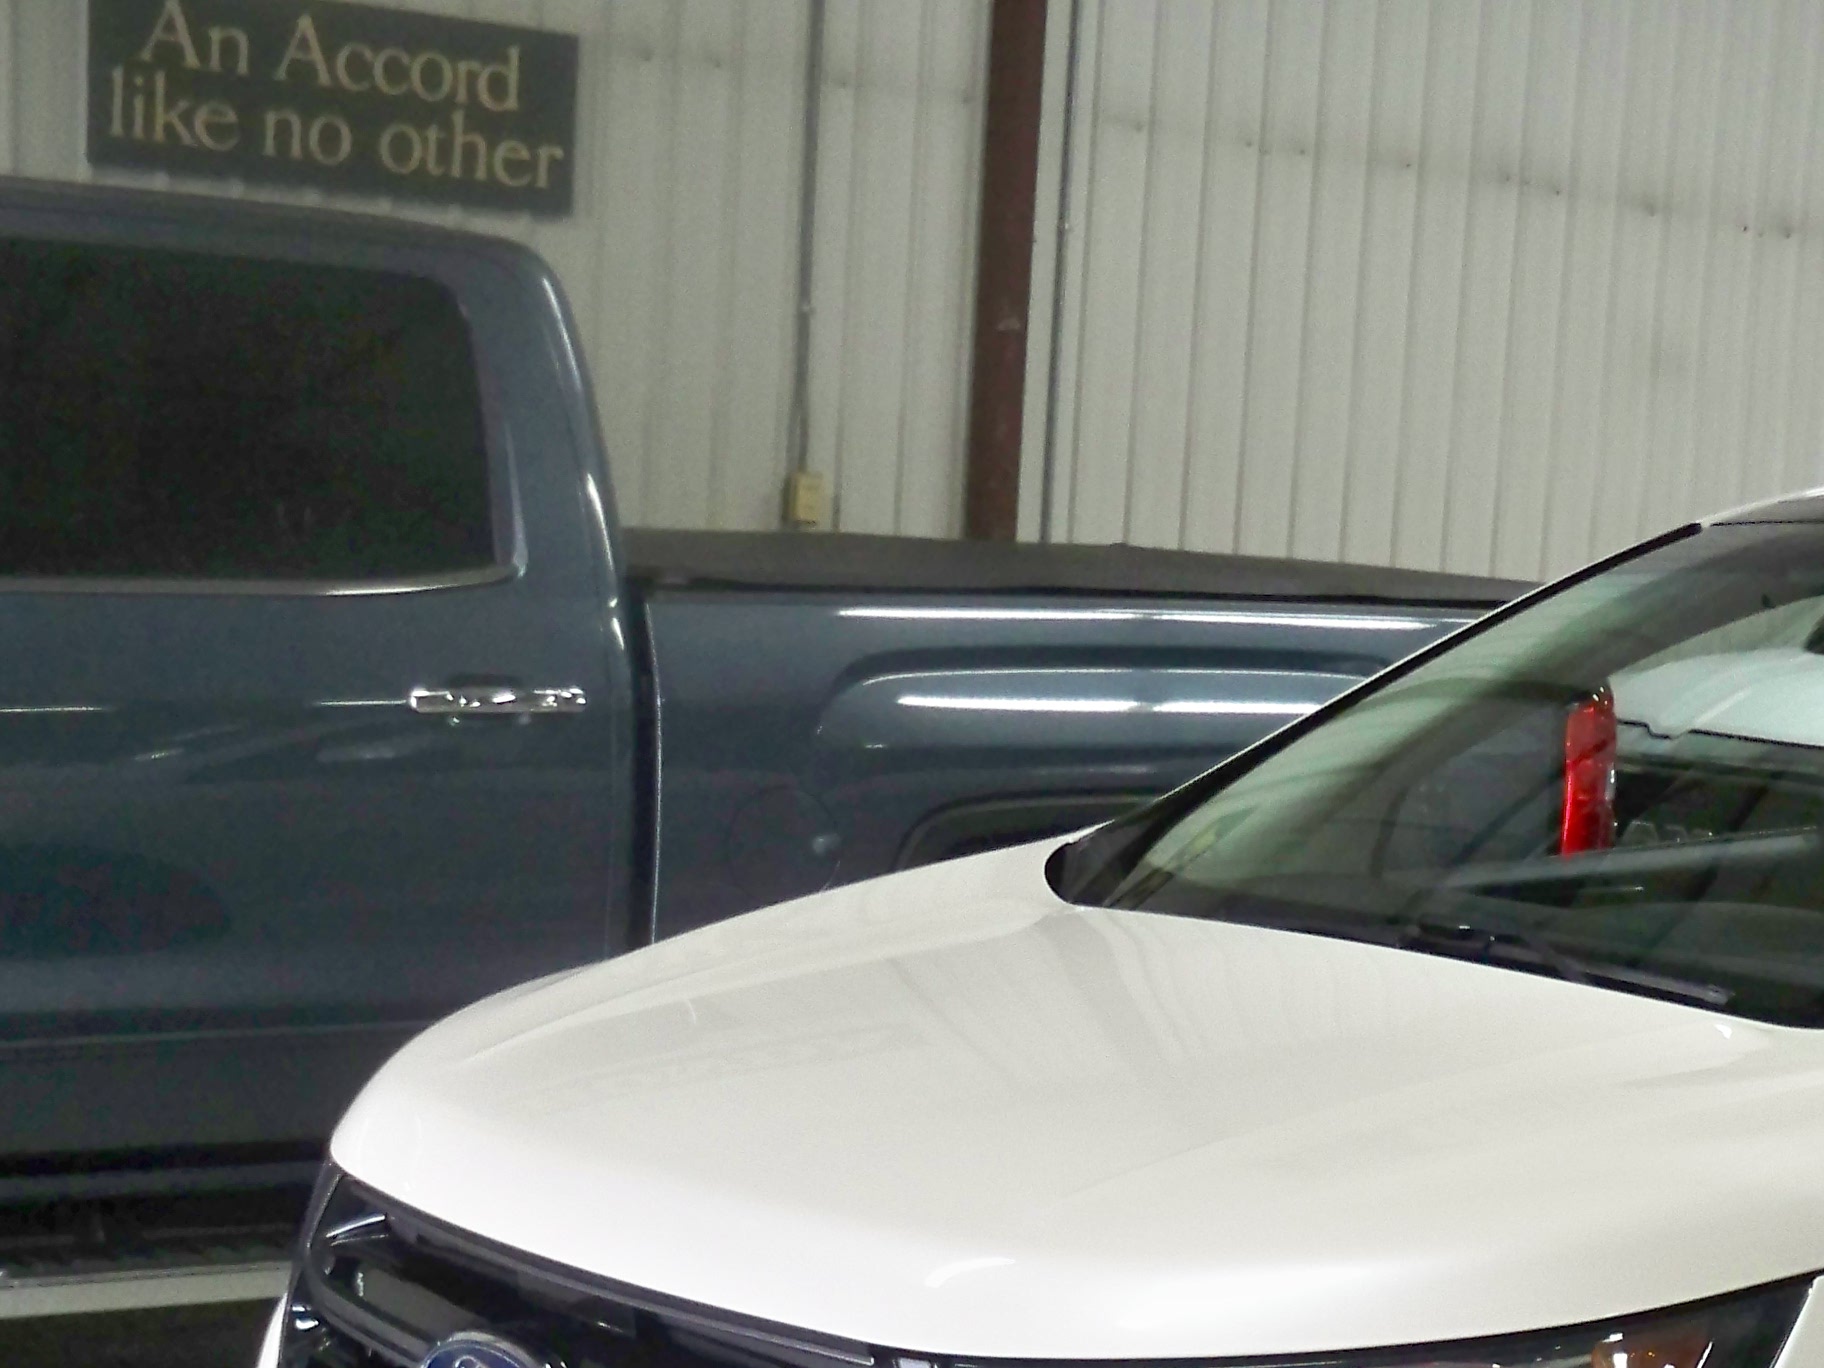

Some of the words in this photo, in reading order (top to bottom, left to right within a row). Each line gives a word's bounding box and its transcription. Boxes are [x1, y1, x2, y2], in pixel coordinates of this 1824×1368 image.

[140, 0, 251, 76] An
[273, 14, 519, 112] Accord
[109, 66, 240, 152] like
[263, 108, 352, 166] no
[379, 110, 564, 189] other
